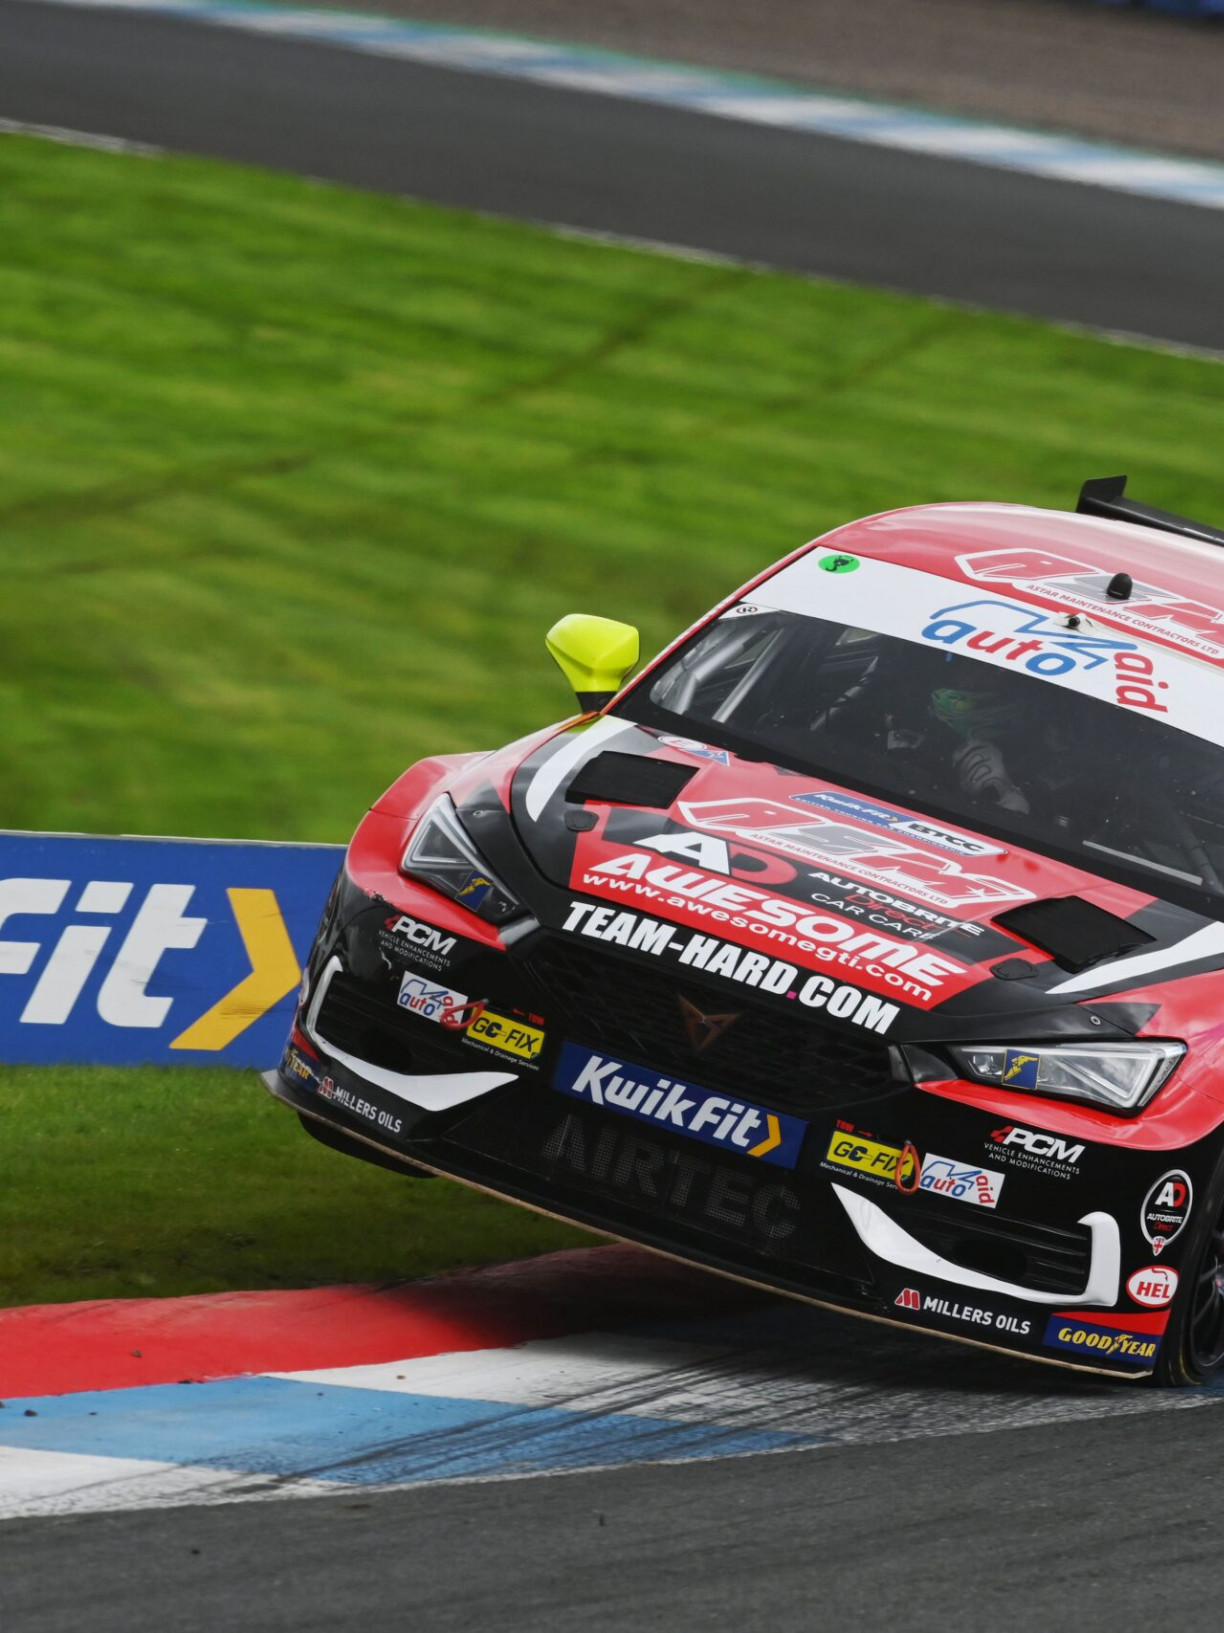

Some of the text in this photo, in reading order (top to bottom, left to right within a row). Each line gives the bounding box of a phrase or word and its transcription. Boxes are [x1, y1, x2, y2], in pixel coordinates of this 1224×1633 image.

[1026, 583, 1220, 655] ASTAR MAINTENANCE CONTRACTORS LTD
[921, 618, 1077, 676] auto
[1113, 651, 1170, 714] aid
[908, 822, 985, 852] BTCC
[783, 840, 857, 874] MAINTENANCE
[858, 868, 928, 897] CONTRACTORS
[928, 894, 949, 905] LTD
[588, 852, 968, 987] AWESOME
[808, 871, 986, 936] AUTOBRITE
[811, 892, 865, 916] CAR
[391, 915, 457, 956] PCM
[582, 873, 932, 1002] www.awesomegti.com
[561, 901, 901, 1035] TEAM-HARD.COM
[399, 990, 435, 1017] auto
[333, 1084, 403, 1134] MILLERS OILS
[984, 1142, 1081, 1175] VEHICLE ENHANCEMENTS
[1002, 1127, 1087, 1164] PCM
[542, 1113, 801, 1240] AIRTEC
[819, 1161, 852, 1176] Mechanical
[858, 1173, 885, 1187] Drainage
[988, 1152, 1072, 1180] AND MODIFICATIONS
[920, 1174, 967, 1197] auto
[975, 1174, 995, 1204] aid
[1154, 1182, 1187, 1208] AD
[1136, 1280, 1170, 1299] HEL
[923, 1296, 1031, 1335] MILLERS OILS
[1058, 1327, 1157, 1358] GOODYEAR
